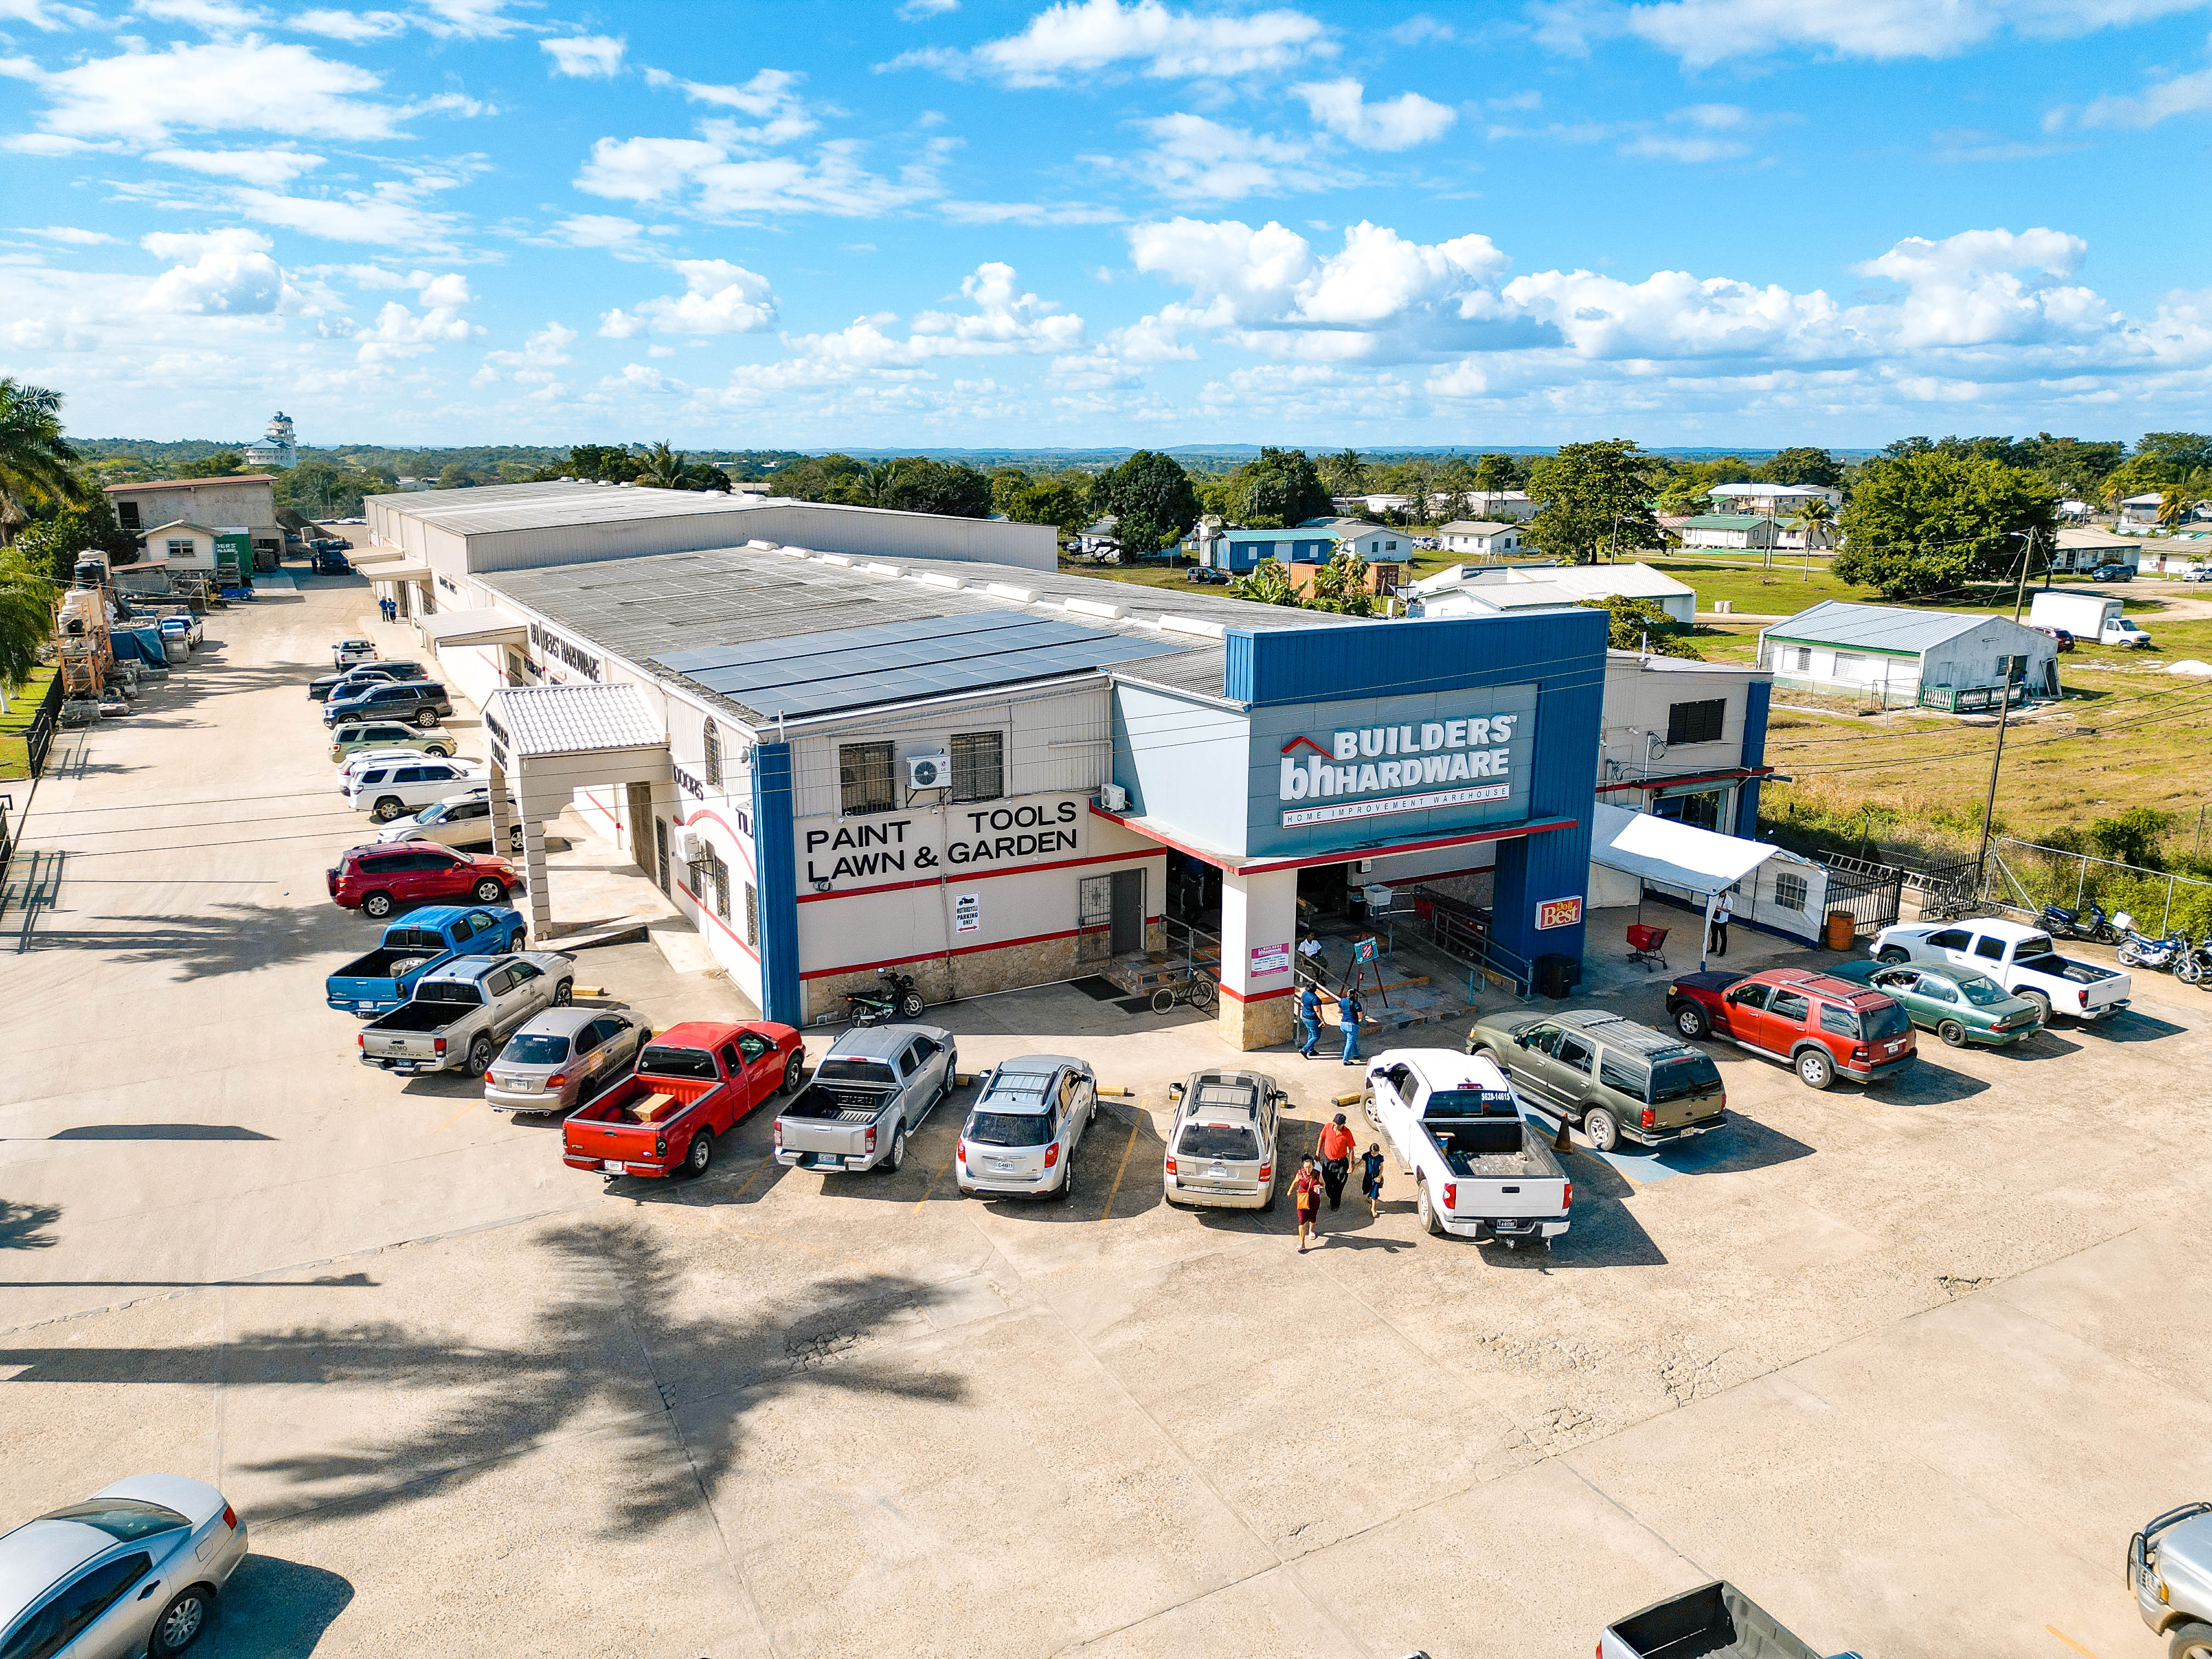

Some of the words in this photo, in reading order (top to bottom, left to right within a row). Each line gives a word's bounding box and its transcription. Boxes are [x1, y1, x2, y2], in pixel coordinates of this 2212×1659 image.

[673, 764, 704, 802] DOORS
[1280, 755, 1335, 801] bh
[1333, 748, 1509, 795] HARDWARE
[1287, 811, 1322, 823] HOME
[1331, 798, 1424, 817] IMPROVEMENT
[1433, 787, 1507, 804] WAREHOUSE
[807, 820, 911, 853] PAINT
[967, 801, 1076, 833] TOOLS
[808, 850, 905, 883] LAWN
[914, 847, 939, 868] &
[948, 829, 1076, 864] GARDEN
[1542, 905, 1578, 927] Best
[838, 1095, 873, 1104] ISUZU
